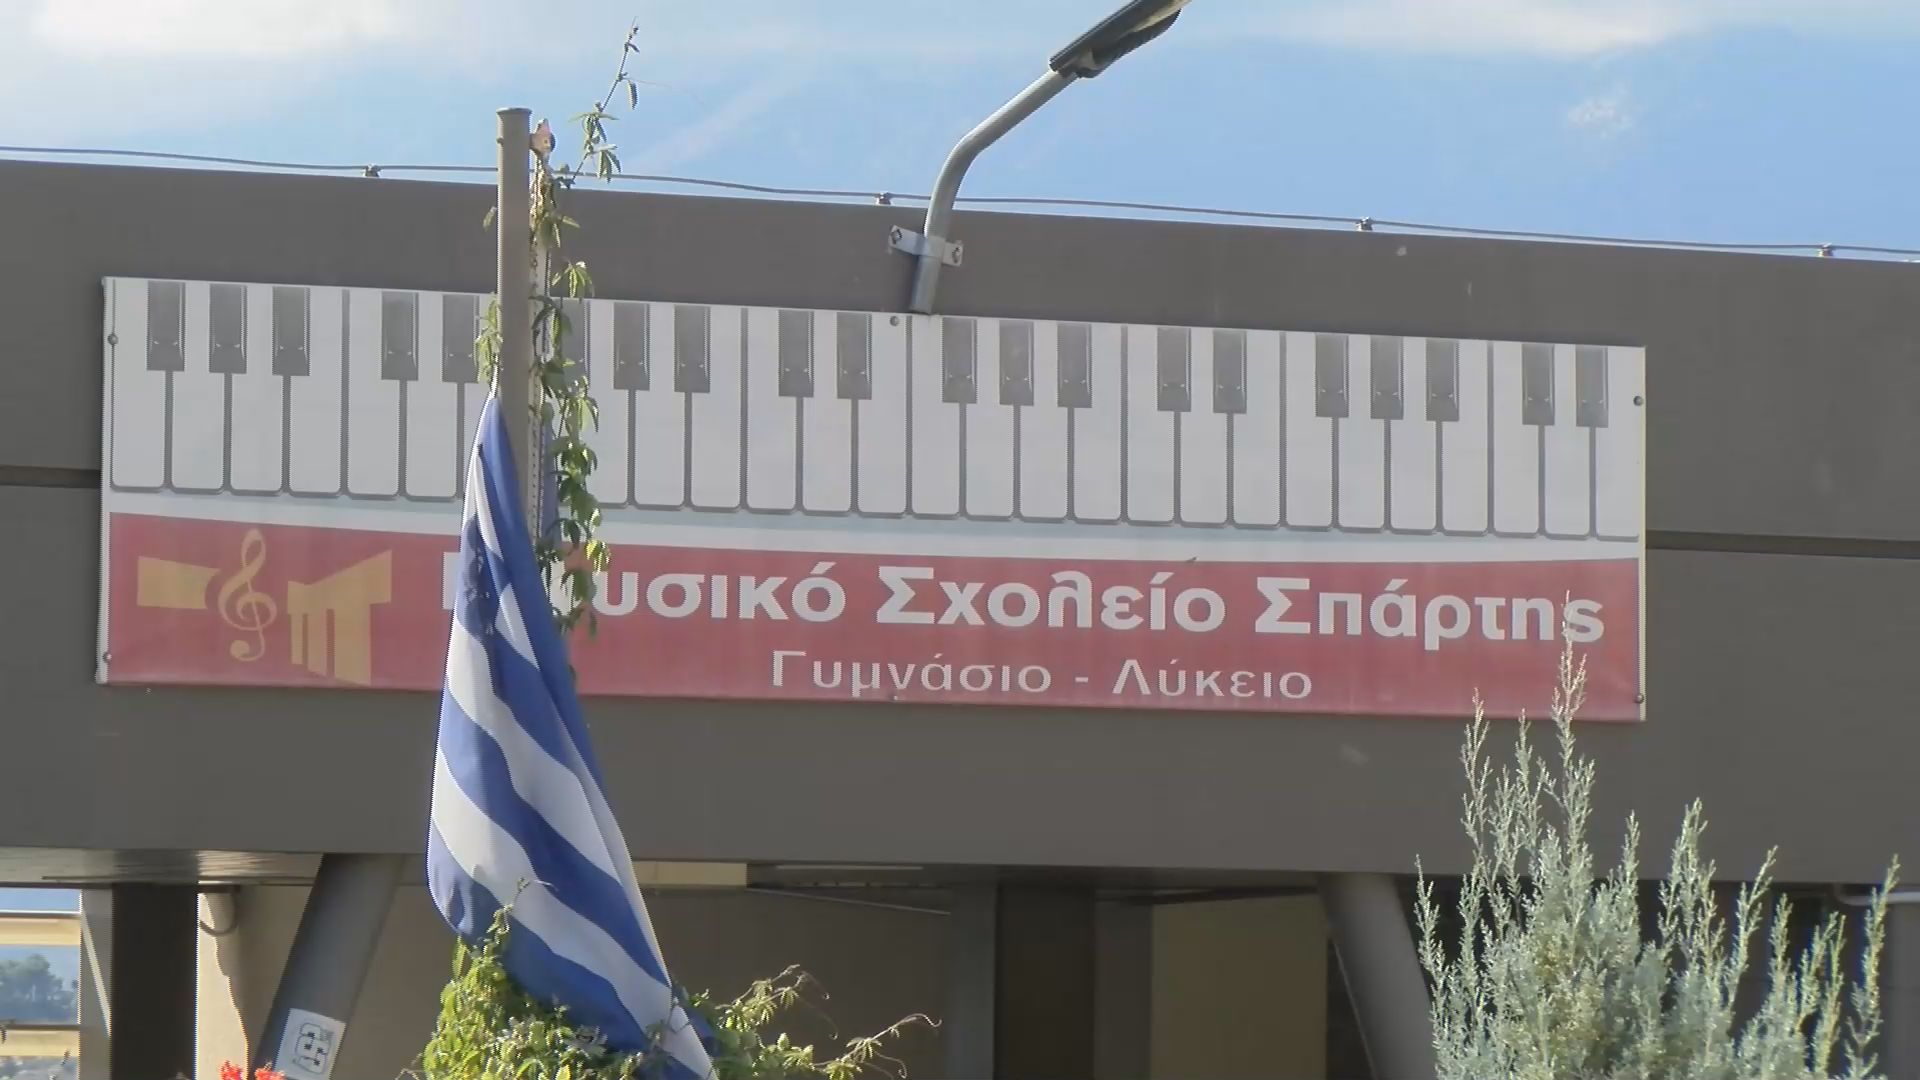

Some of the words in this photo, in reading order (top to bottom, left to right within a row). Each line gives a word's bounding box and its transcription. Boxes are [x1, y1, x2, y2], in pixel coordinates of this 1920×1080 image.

[876, 565, 1226, 633] Σχολείο
[1255, 576, 1605, 651] Σπάρτης
[772, 650, 1051, 700] Γυμνάσιο
[1111, 657, 1312, 699] Λύκειο
